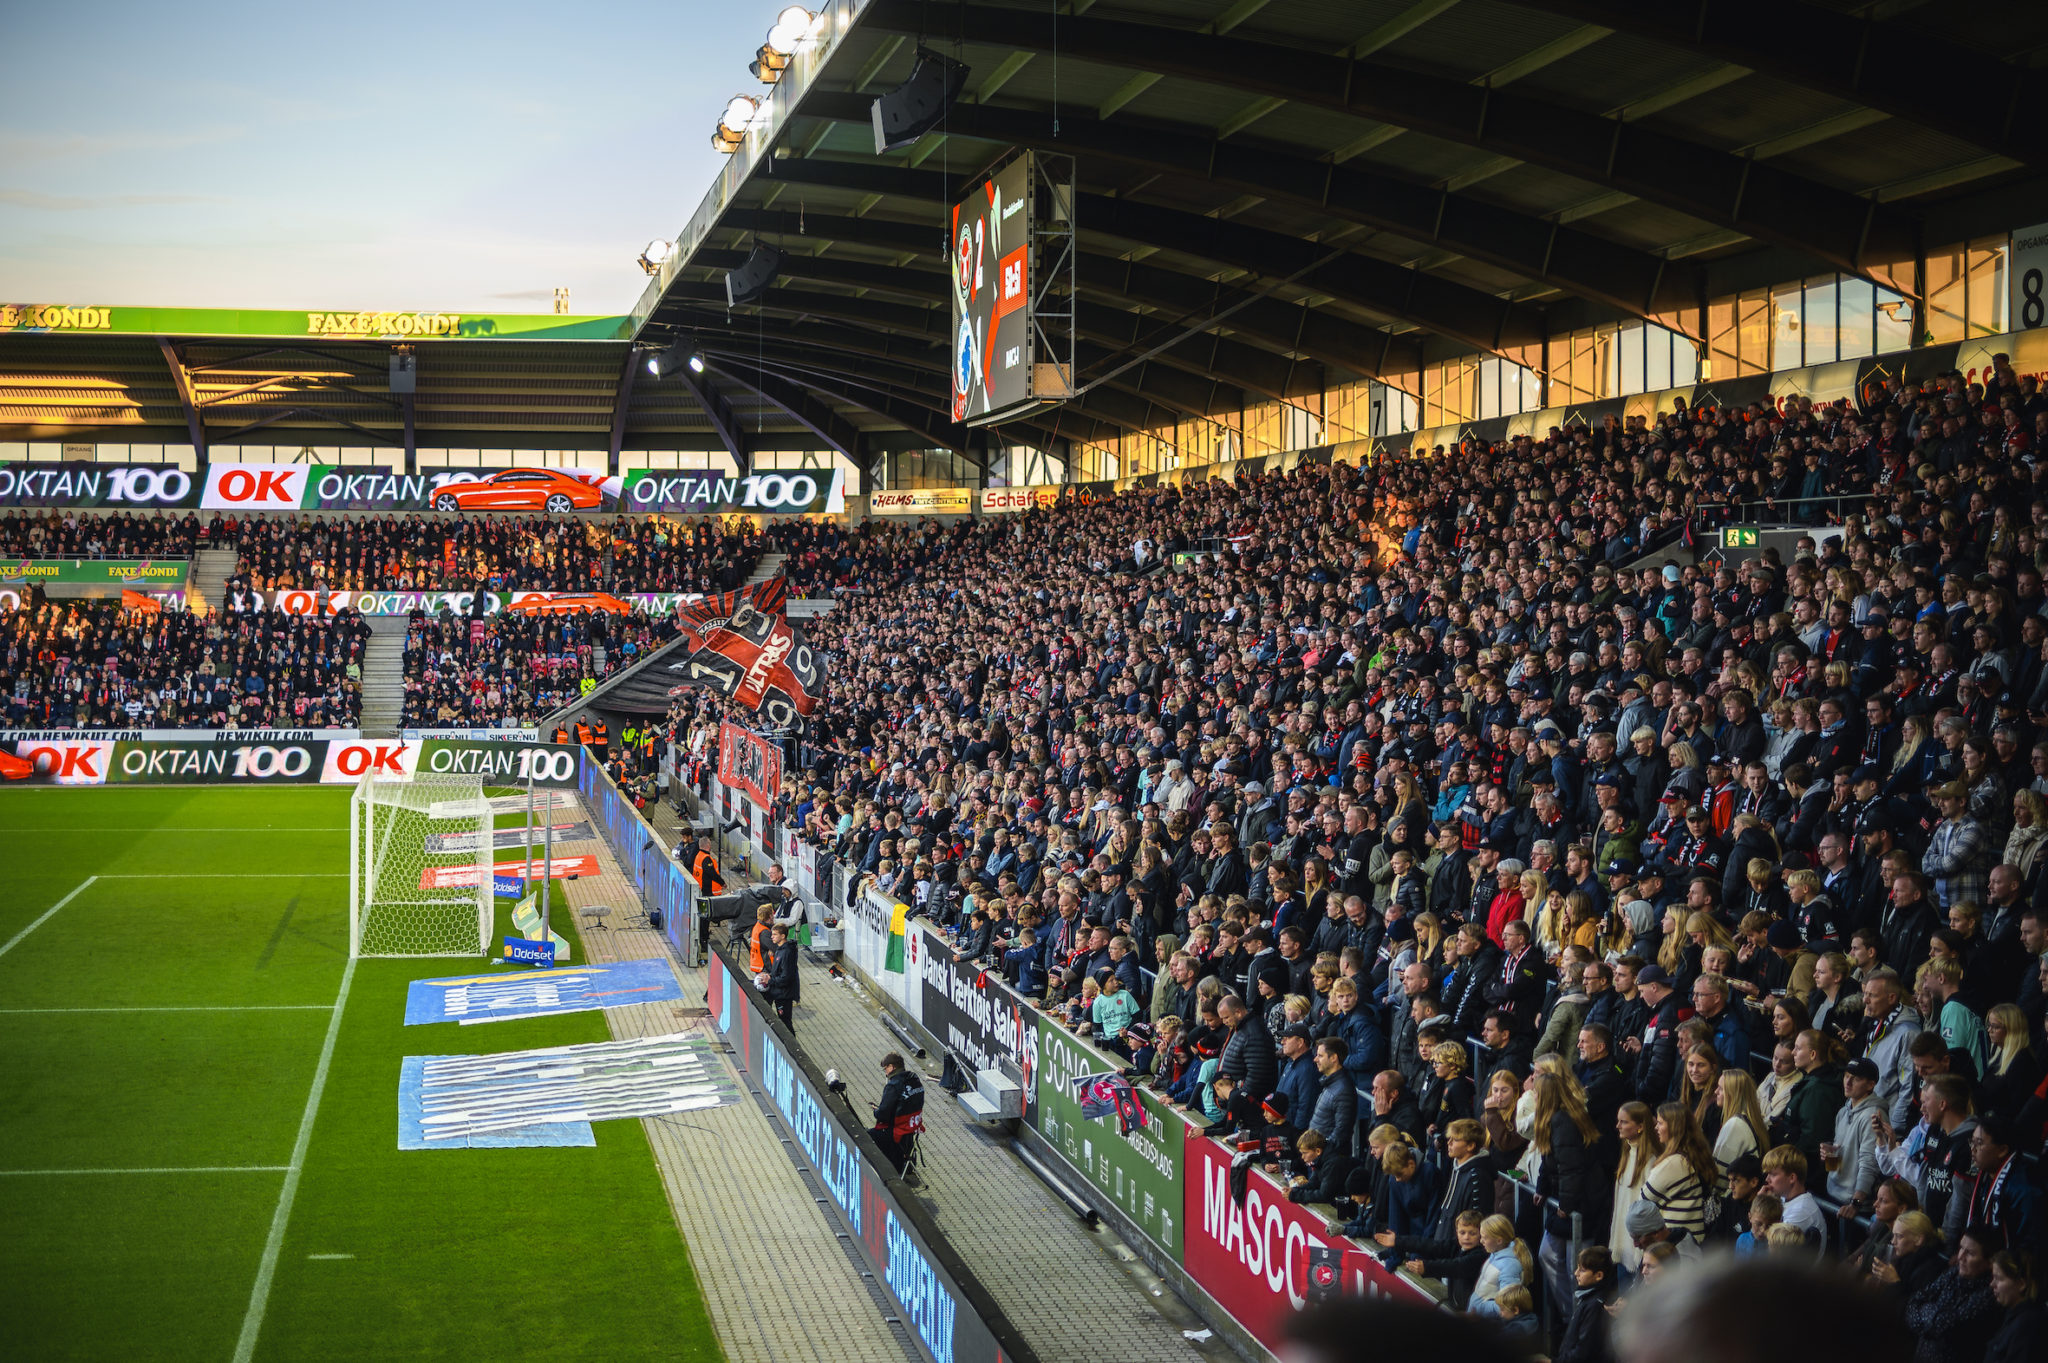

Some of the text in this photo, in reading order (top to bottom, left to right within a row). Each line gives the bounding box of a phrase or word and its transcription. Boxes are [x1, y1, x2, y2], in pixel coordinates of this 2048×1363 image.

[975, 218, 984, 290] 2
[2022, 268, 2045, 330] 8
[24, 308, 112, 329] KONDI
[307, 313, 461, 335] FAXE KONDI
[1373, 400, 1382, 436] 7
[0, 467, 191, 502] OKTAN 100
[218, 470, 296, 502] OK
[317, 474, 425, 501] OKTAN
[633, 477, 737, 504] OKTAN
[741, 474, 817, 507] 100
[877, 493, 914, 508] HELMS
[983, 489, 1057, 508] Schäffer
[21, 566, 60, 576] KONDI
[108, 567, 178, 577] FAXE KONDI
[357, 594, 436, 614] OKTAN
[626, 595, 668, 615] TAN
[745, 633, 792, 695] ULTRAS
[41, 731, 143, 741] HEWIKUT.COM
[215, 730, 314, 741] HEWIKUT.COM
[27, 746, 101, 778] OK
[122, 746, 312, 778] OKTAN 100
[336, 745, 411, 776] OK
[430, 748, 575, 782] OKTAN 100
[493, 879, 522, 894] Oddset
[513, 946, 554, 961] Oddset
[922, 942, 949, 998] Dansk
[950, 963, 993, 1039] Værktøjs
[993, 1000, 1017, 1065] Salg
[776, 1047, 794, 1129] HOME
[795, 1078, 820, 1169] JERSEY
[848, 1146, 861, 1236] PÅ
[1154, 1116, 1165, 1143] TIL
